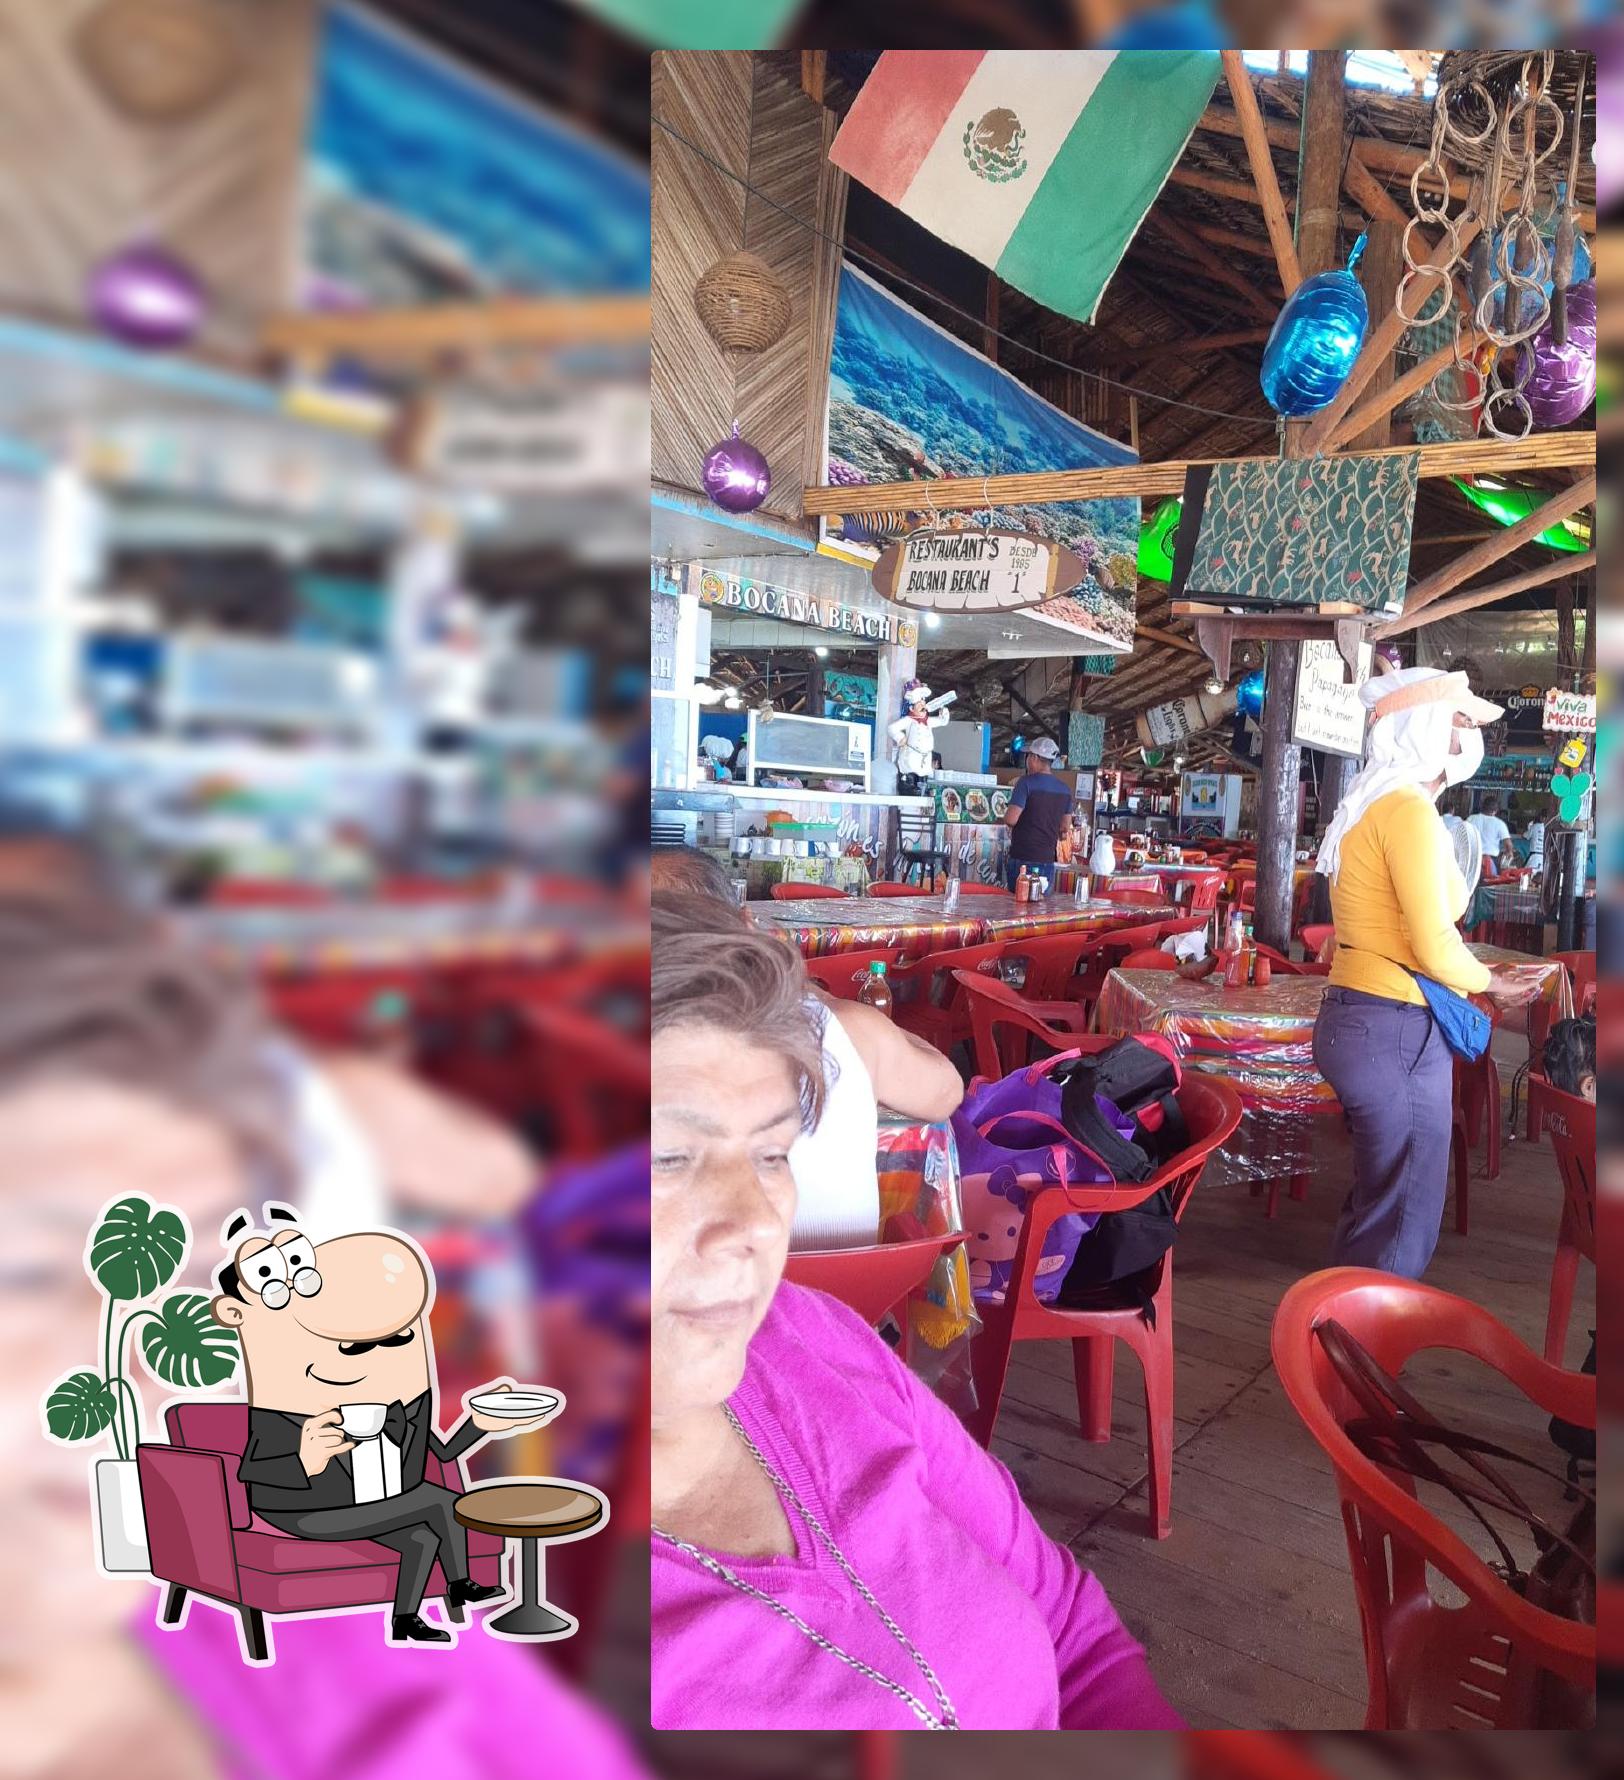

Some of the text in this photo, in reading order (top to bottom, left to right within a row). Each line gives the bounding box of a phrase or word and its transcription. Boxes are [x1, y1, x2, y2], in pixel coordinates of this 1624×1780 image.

[908, 537, 999, 561] RESTAURANT'S
[907, 570, 991, 593] BOCANA BEACH
[726, 581, 891, 641] BOCANA BEACH
[1507, 695, 1545, 711] Coron
[1547, 711, 1596, 728] Mexico
